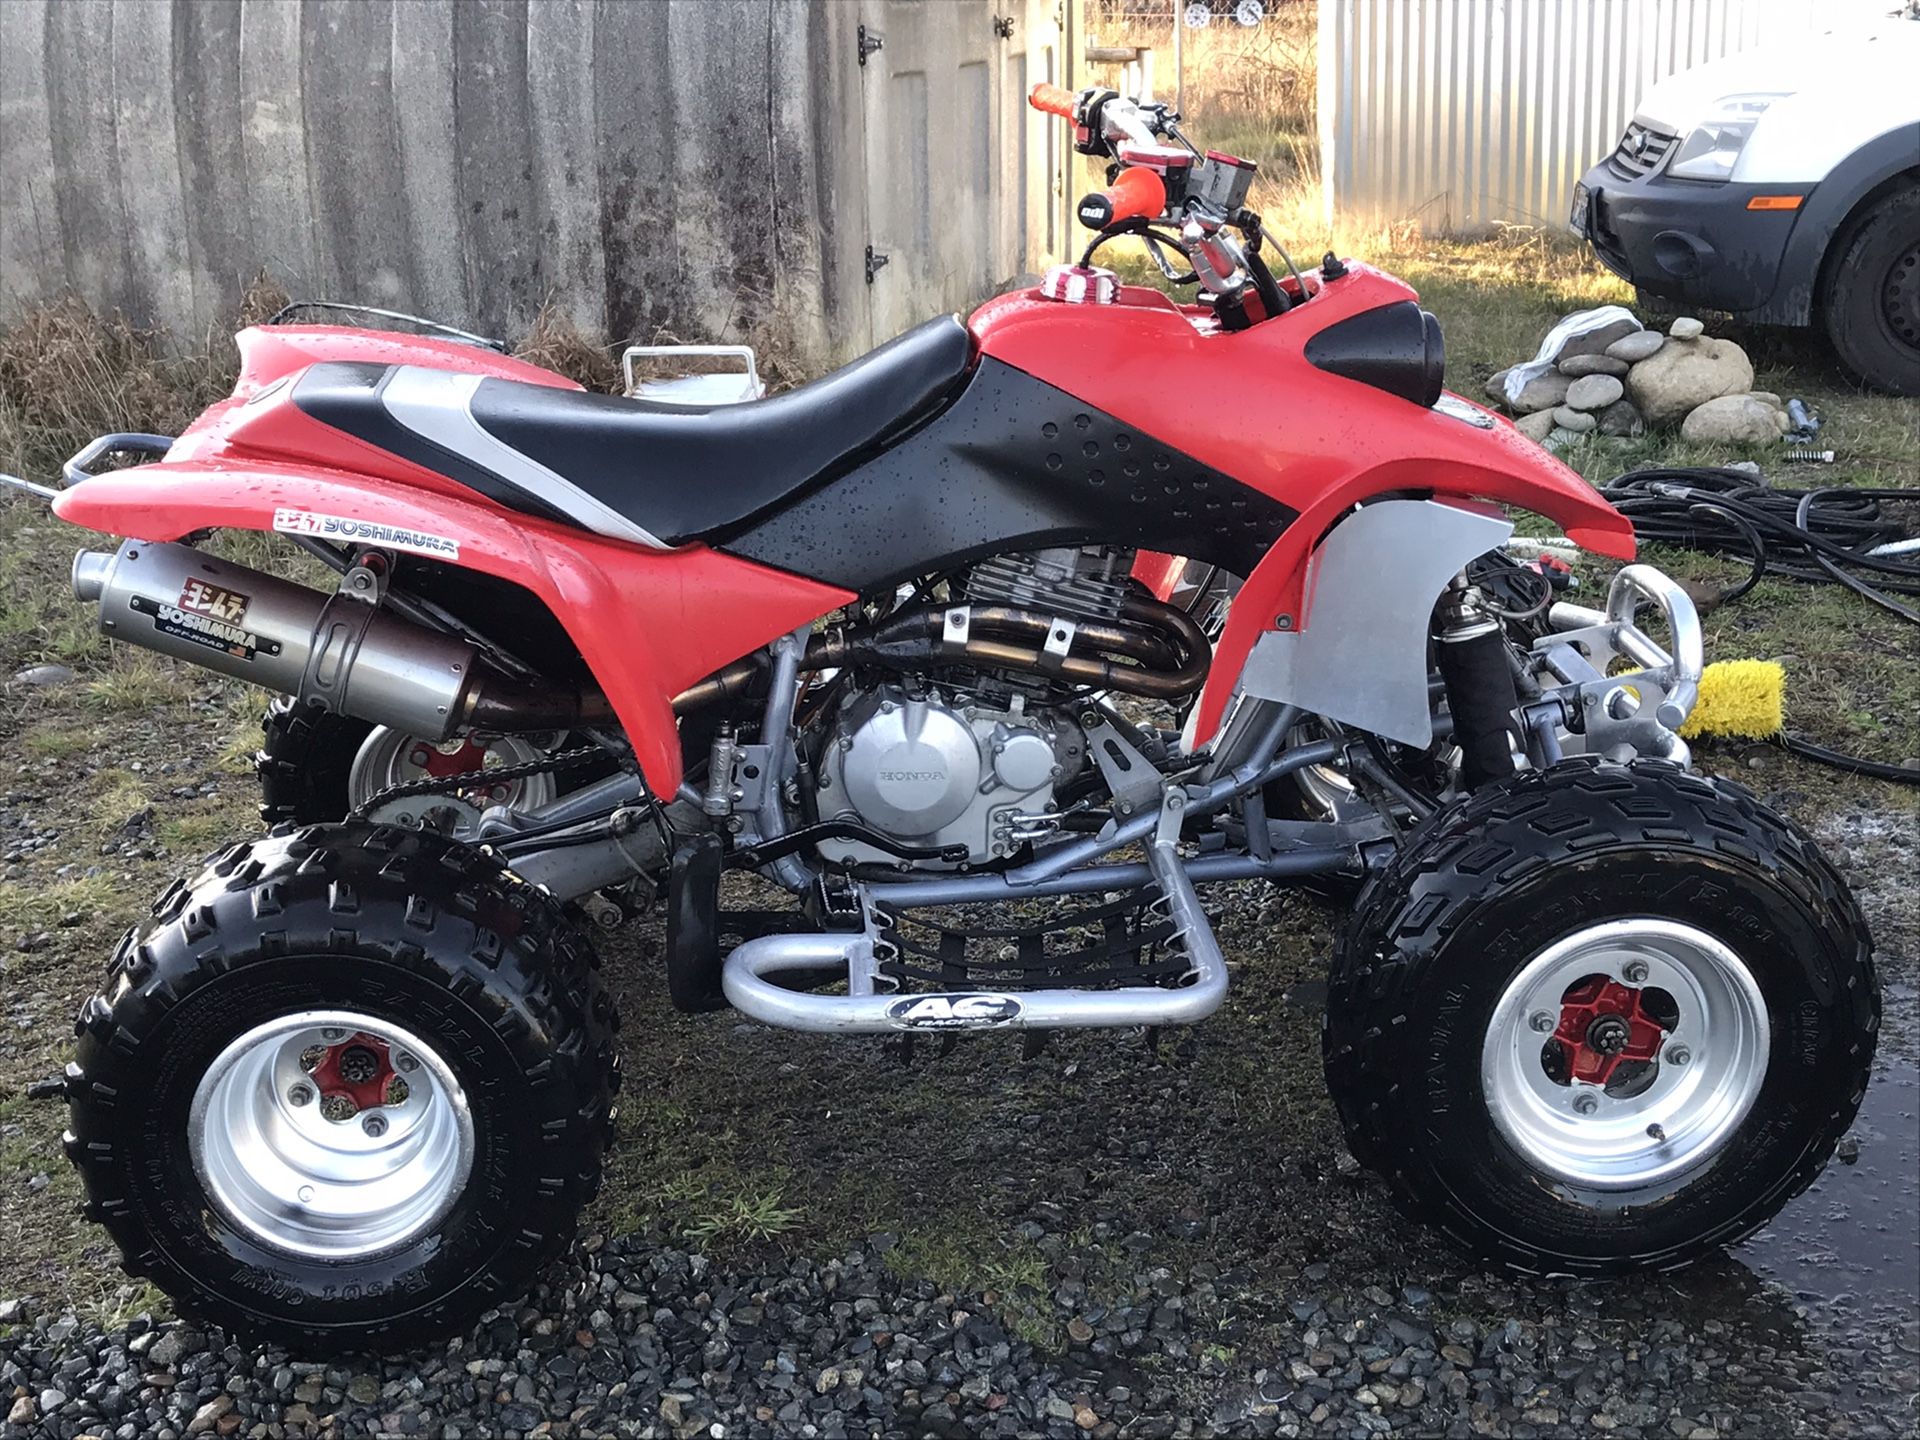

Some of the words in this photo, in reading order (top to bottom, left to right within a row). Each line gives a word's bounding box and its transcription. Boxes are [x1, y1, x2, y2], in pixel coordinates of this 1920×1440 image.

[324, 517, 456, 554] YOSHIMURA
[157, 604, 258, 651] YOSHIMURA
[165, 625, 225, 650] OFF-ROAD
[879, 771, 947, 782] HONDA
